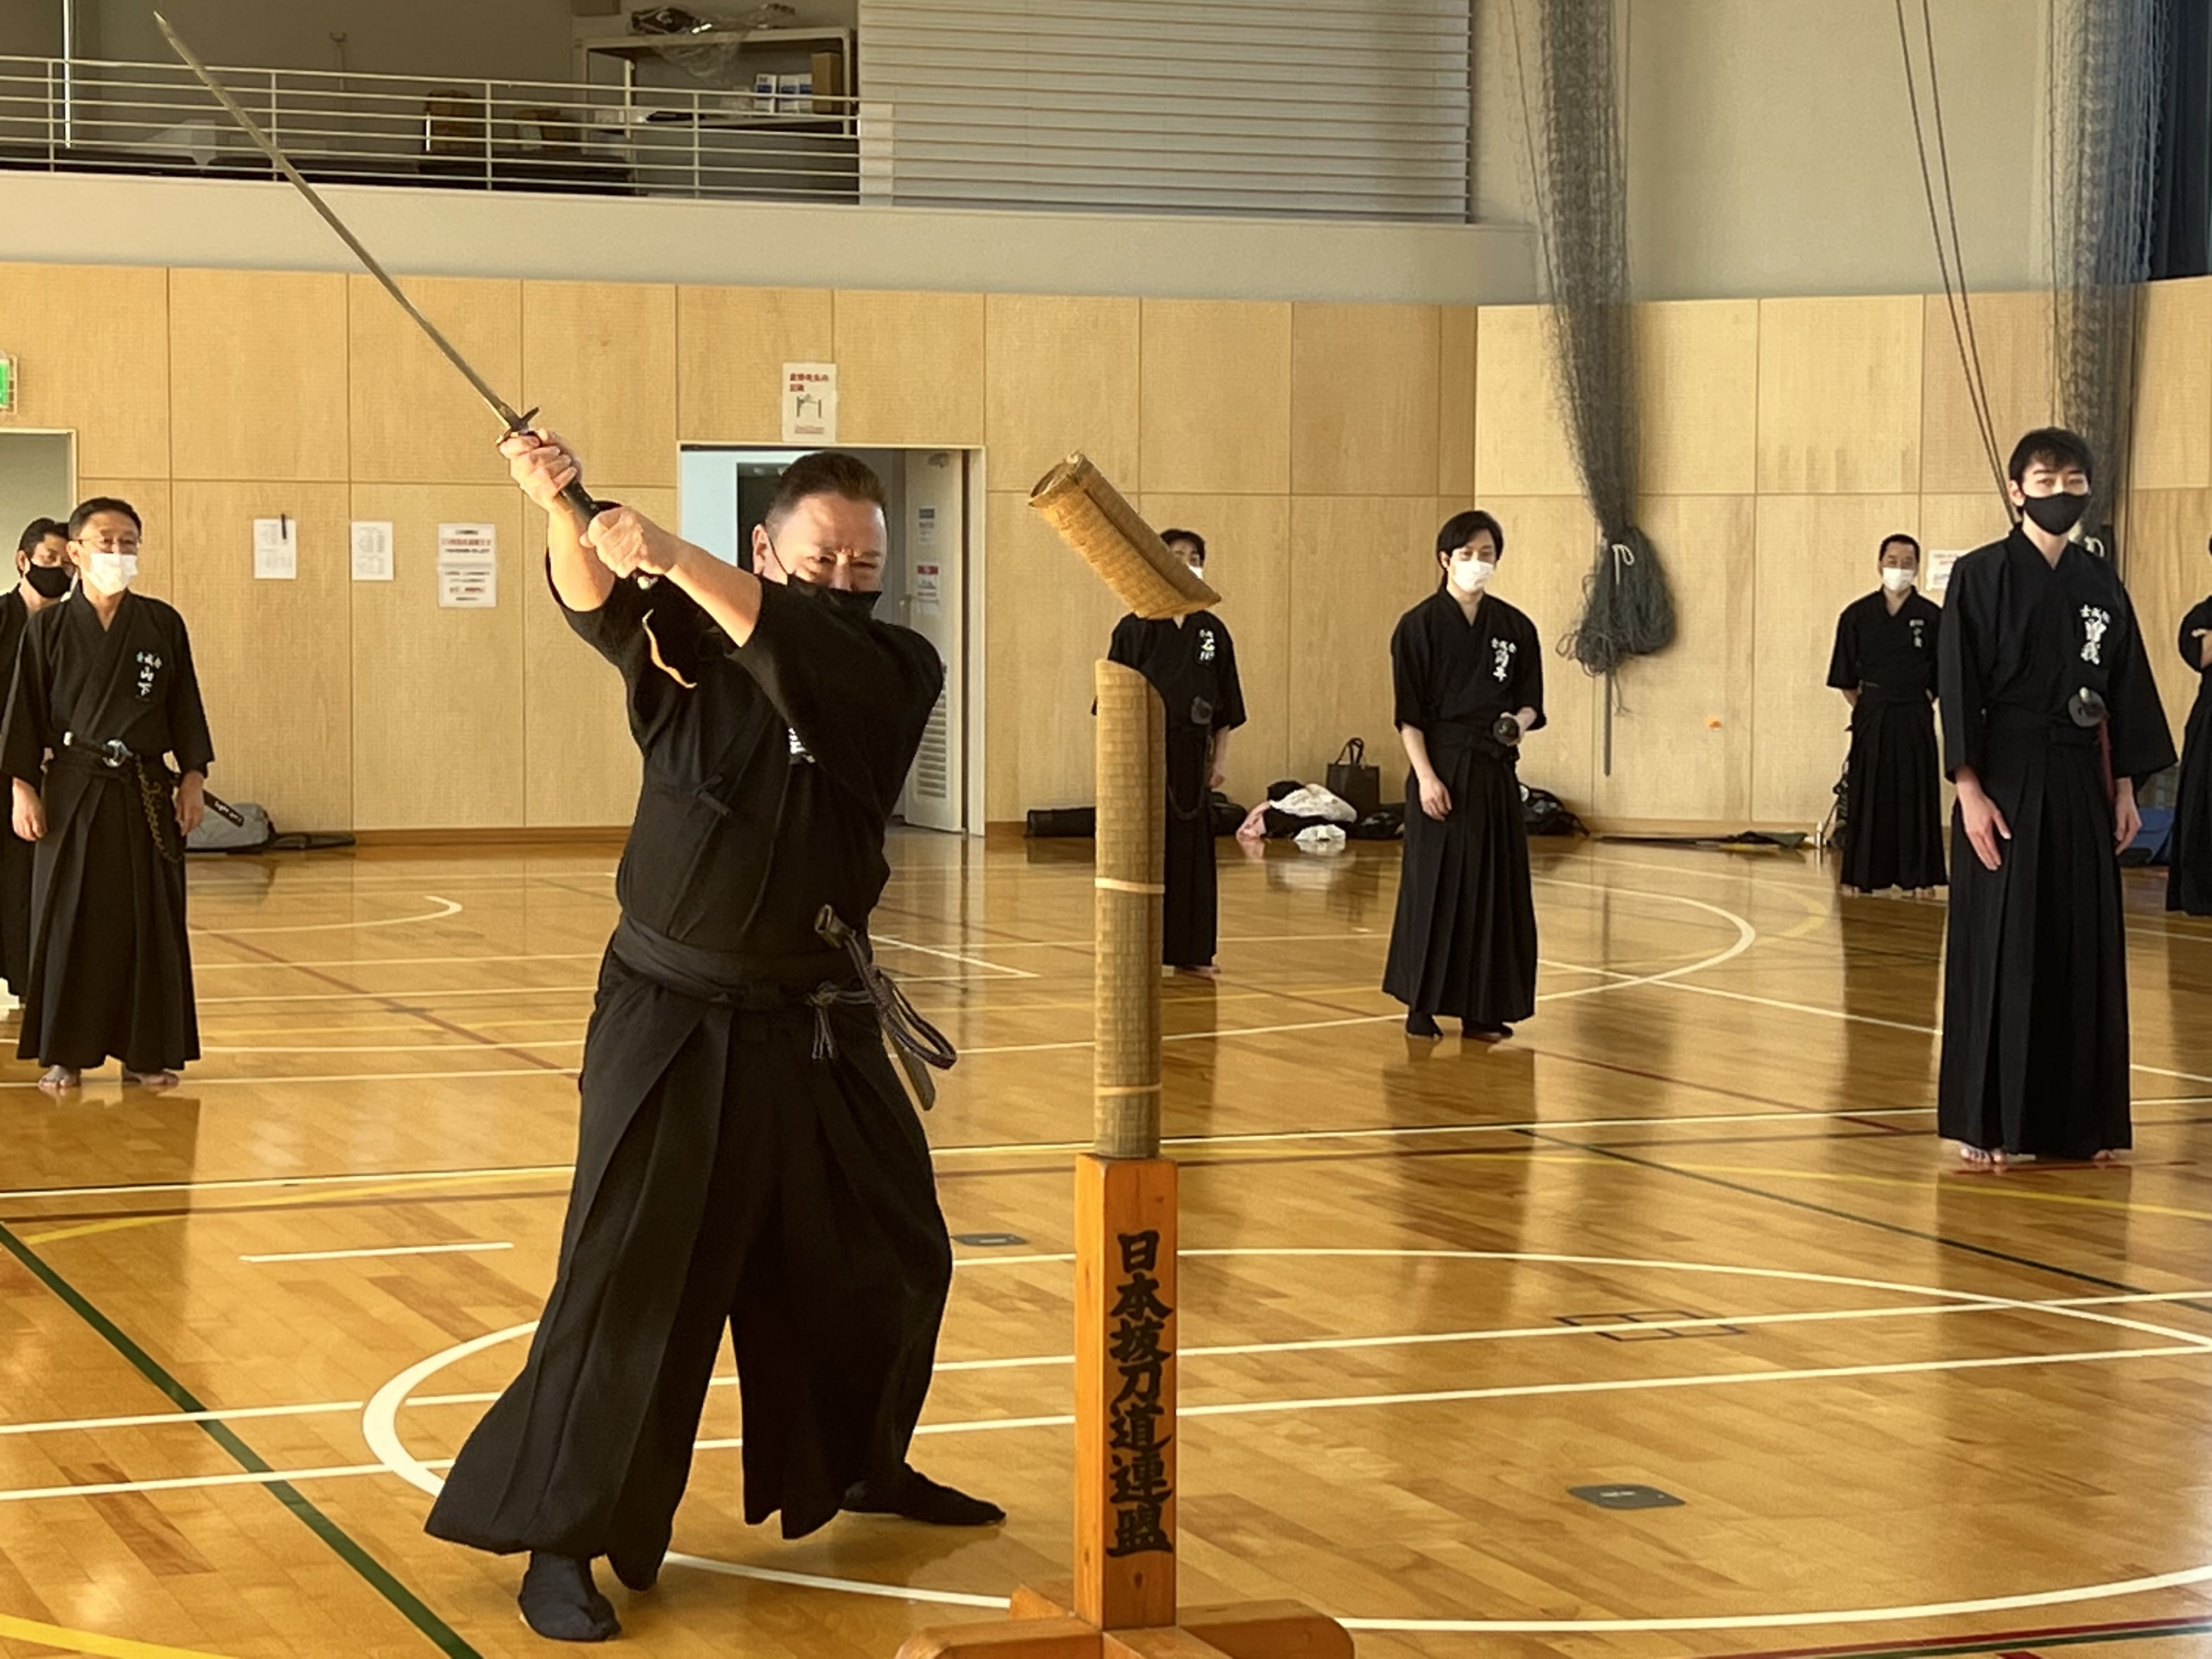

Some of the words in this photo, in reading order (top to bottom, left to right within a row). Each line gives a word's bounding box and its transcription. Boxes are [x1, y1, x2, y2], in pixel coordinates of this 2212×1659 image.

[1106, 1229, 1173, 1558] 日本抜刀道連盟
